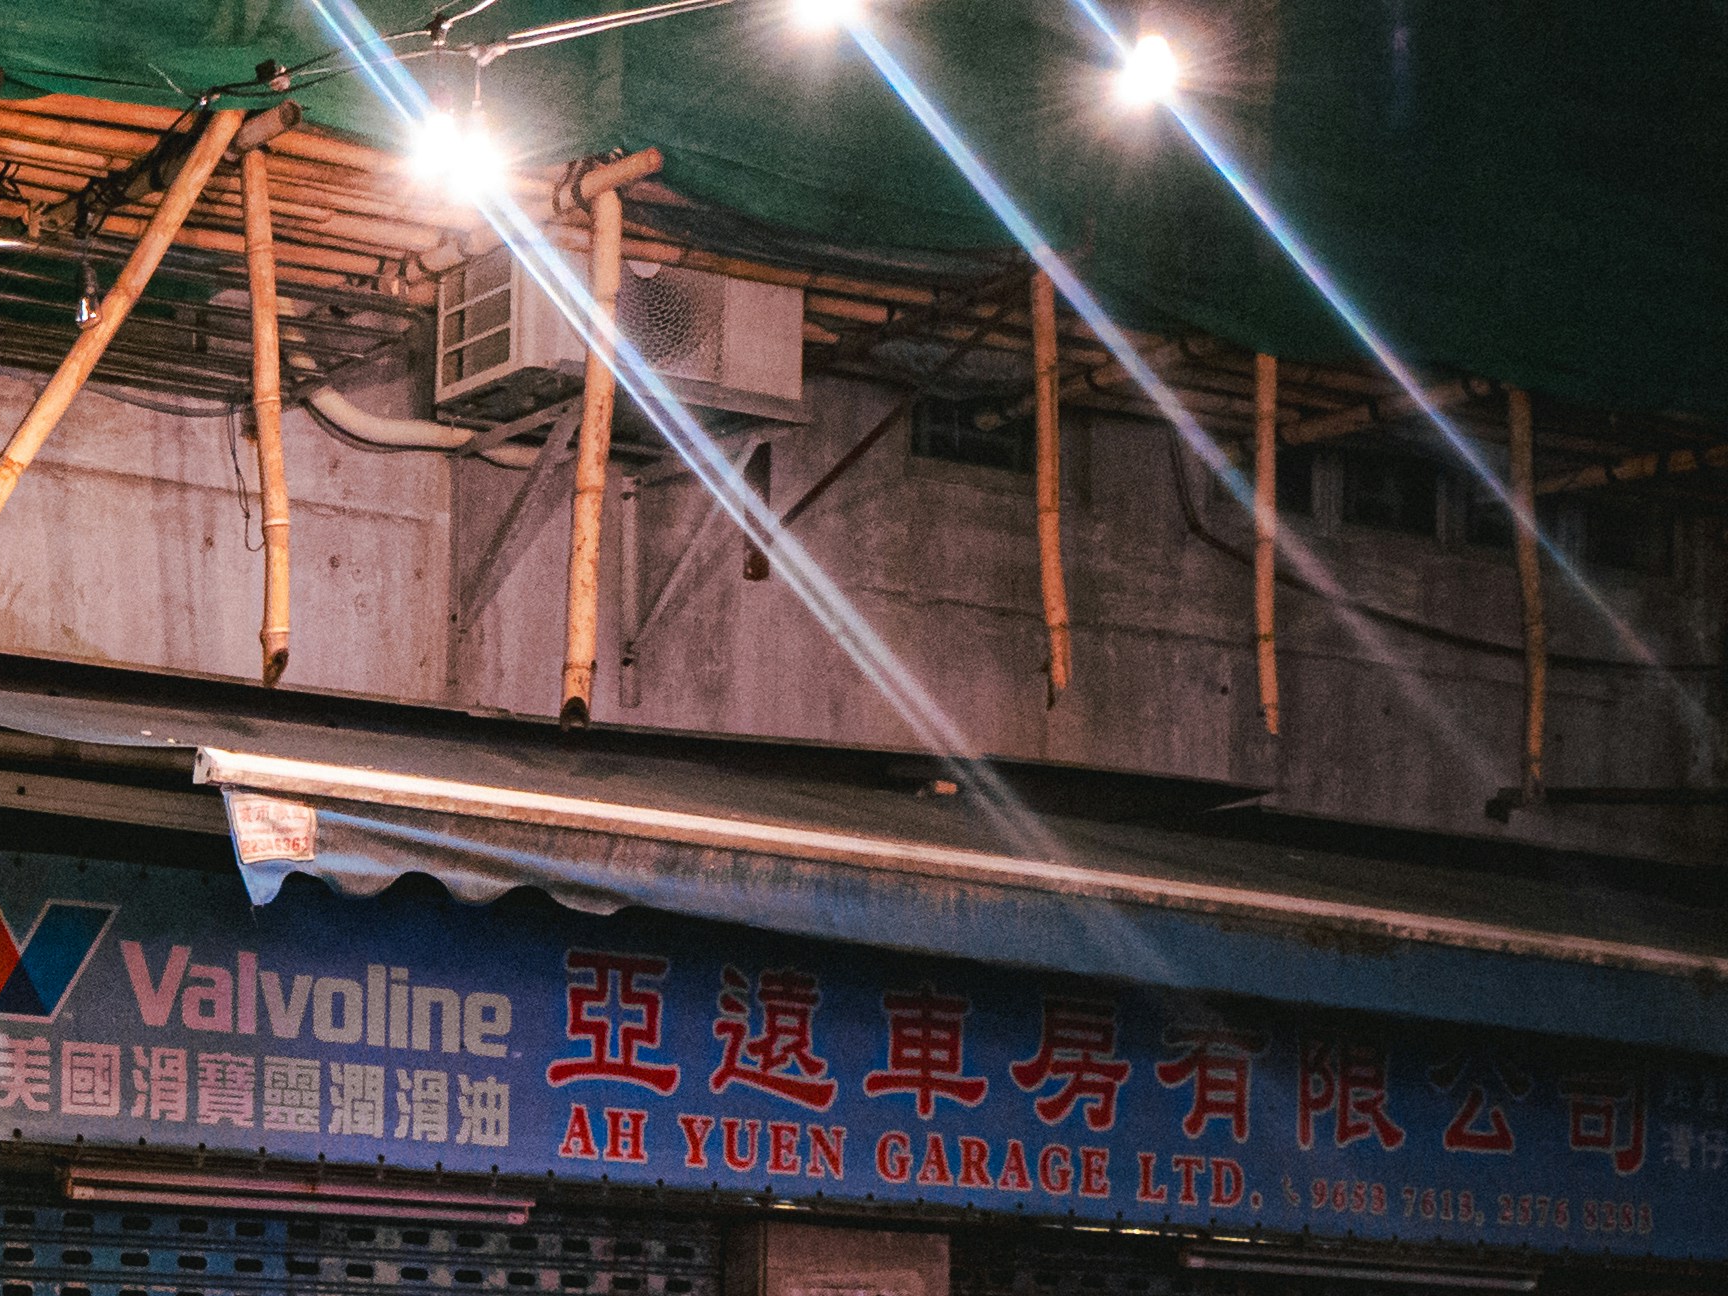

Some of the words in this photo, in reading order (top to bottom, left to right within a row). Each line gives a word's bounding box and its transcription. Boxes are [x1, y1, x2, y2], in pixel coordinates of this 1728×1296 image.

[120, 939, 512, 1058] Valvoline
[558, 1103, 648, 1164] AH
[677, 1113, 847, 1180] YUEN
[875, 1129, 1111, 1199] GARAGE
[1136, 1149, 1264, 1211] LTD.
